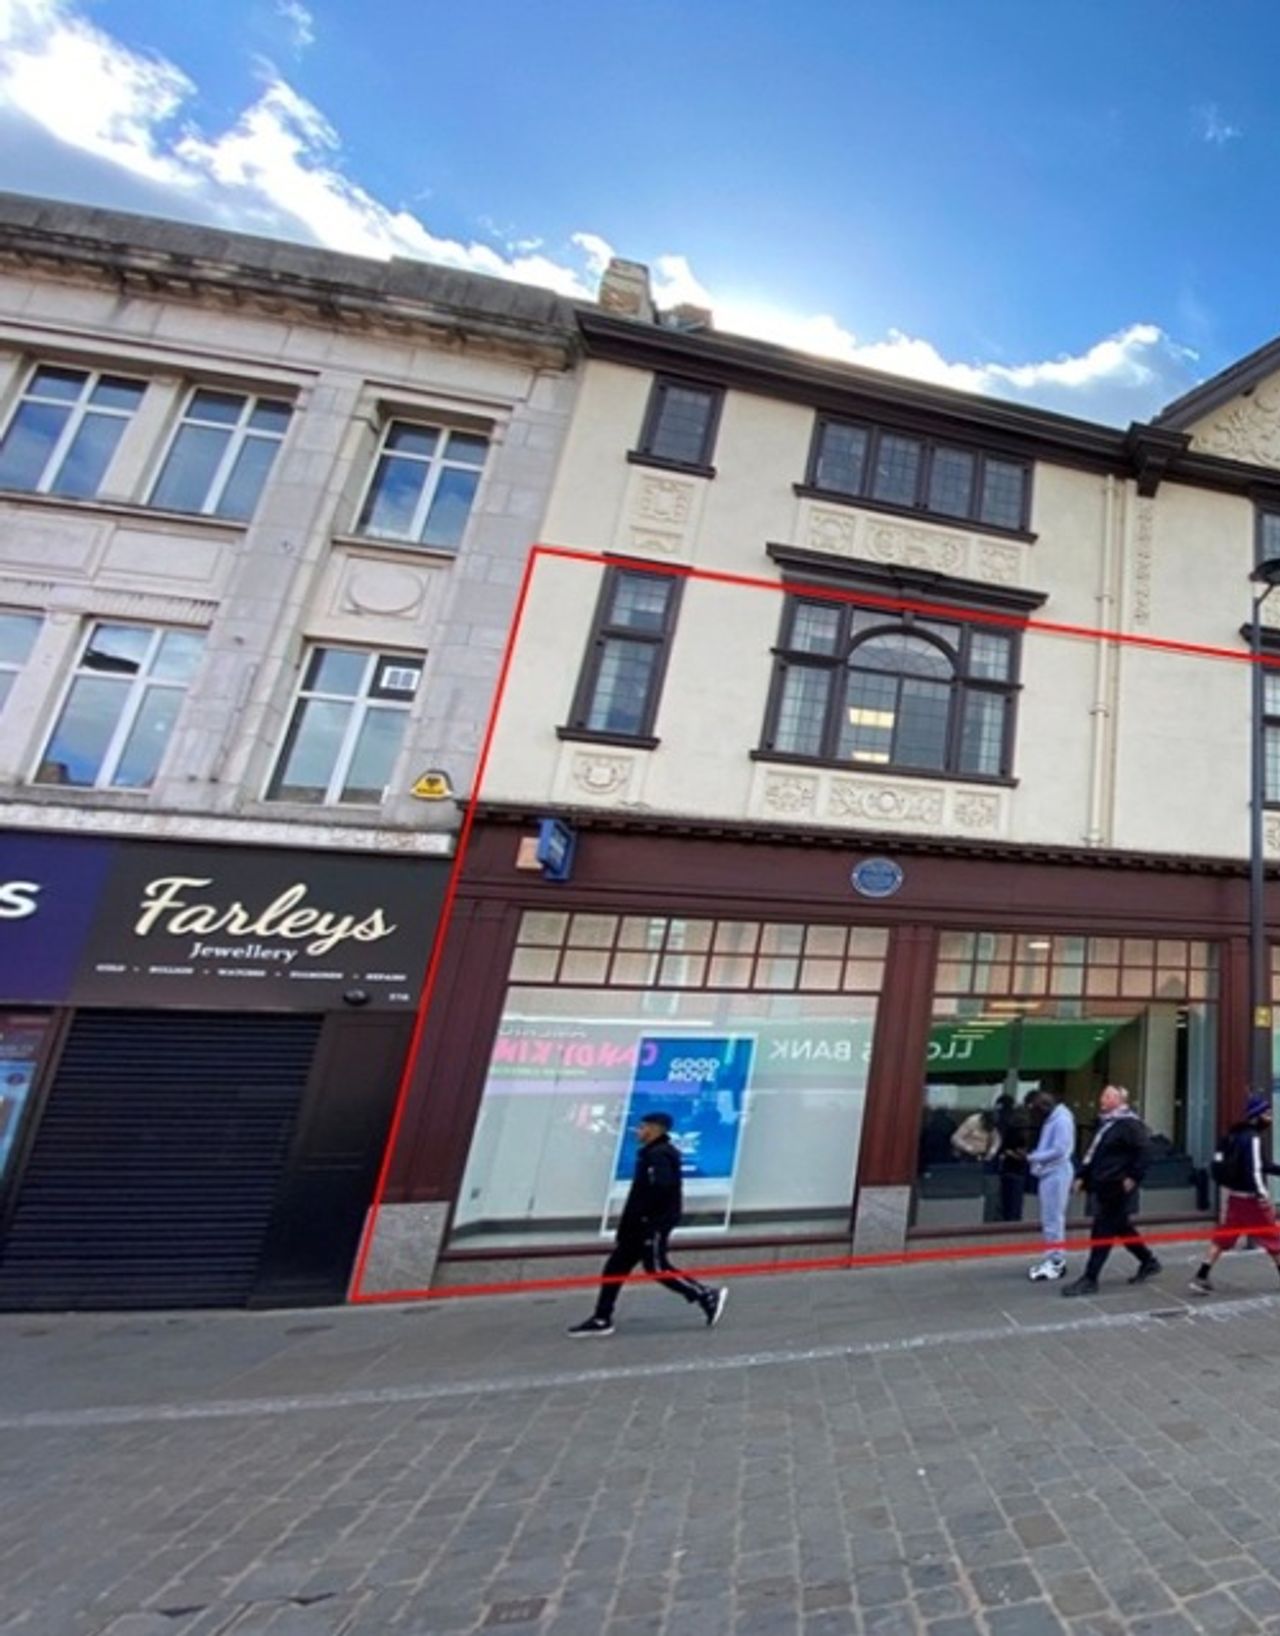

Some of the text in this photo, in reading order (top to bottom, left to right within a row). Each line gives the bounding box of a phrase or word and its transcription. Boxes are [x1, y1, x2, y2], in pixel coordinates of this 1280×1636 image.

[134, 877, 397, 956] Farleys
[188, 942, 299, 963] Jewellery
[670, 1057, 721, 1071] GOOD
[667, 1070, 717, 1082] MOVE
